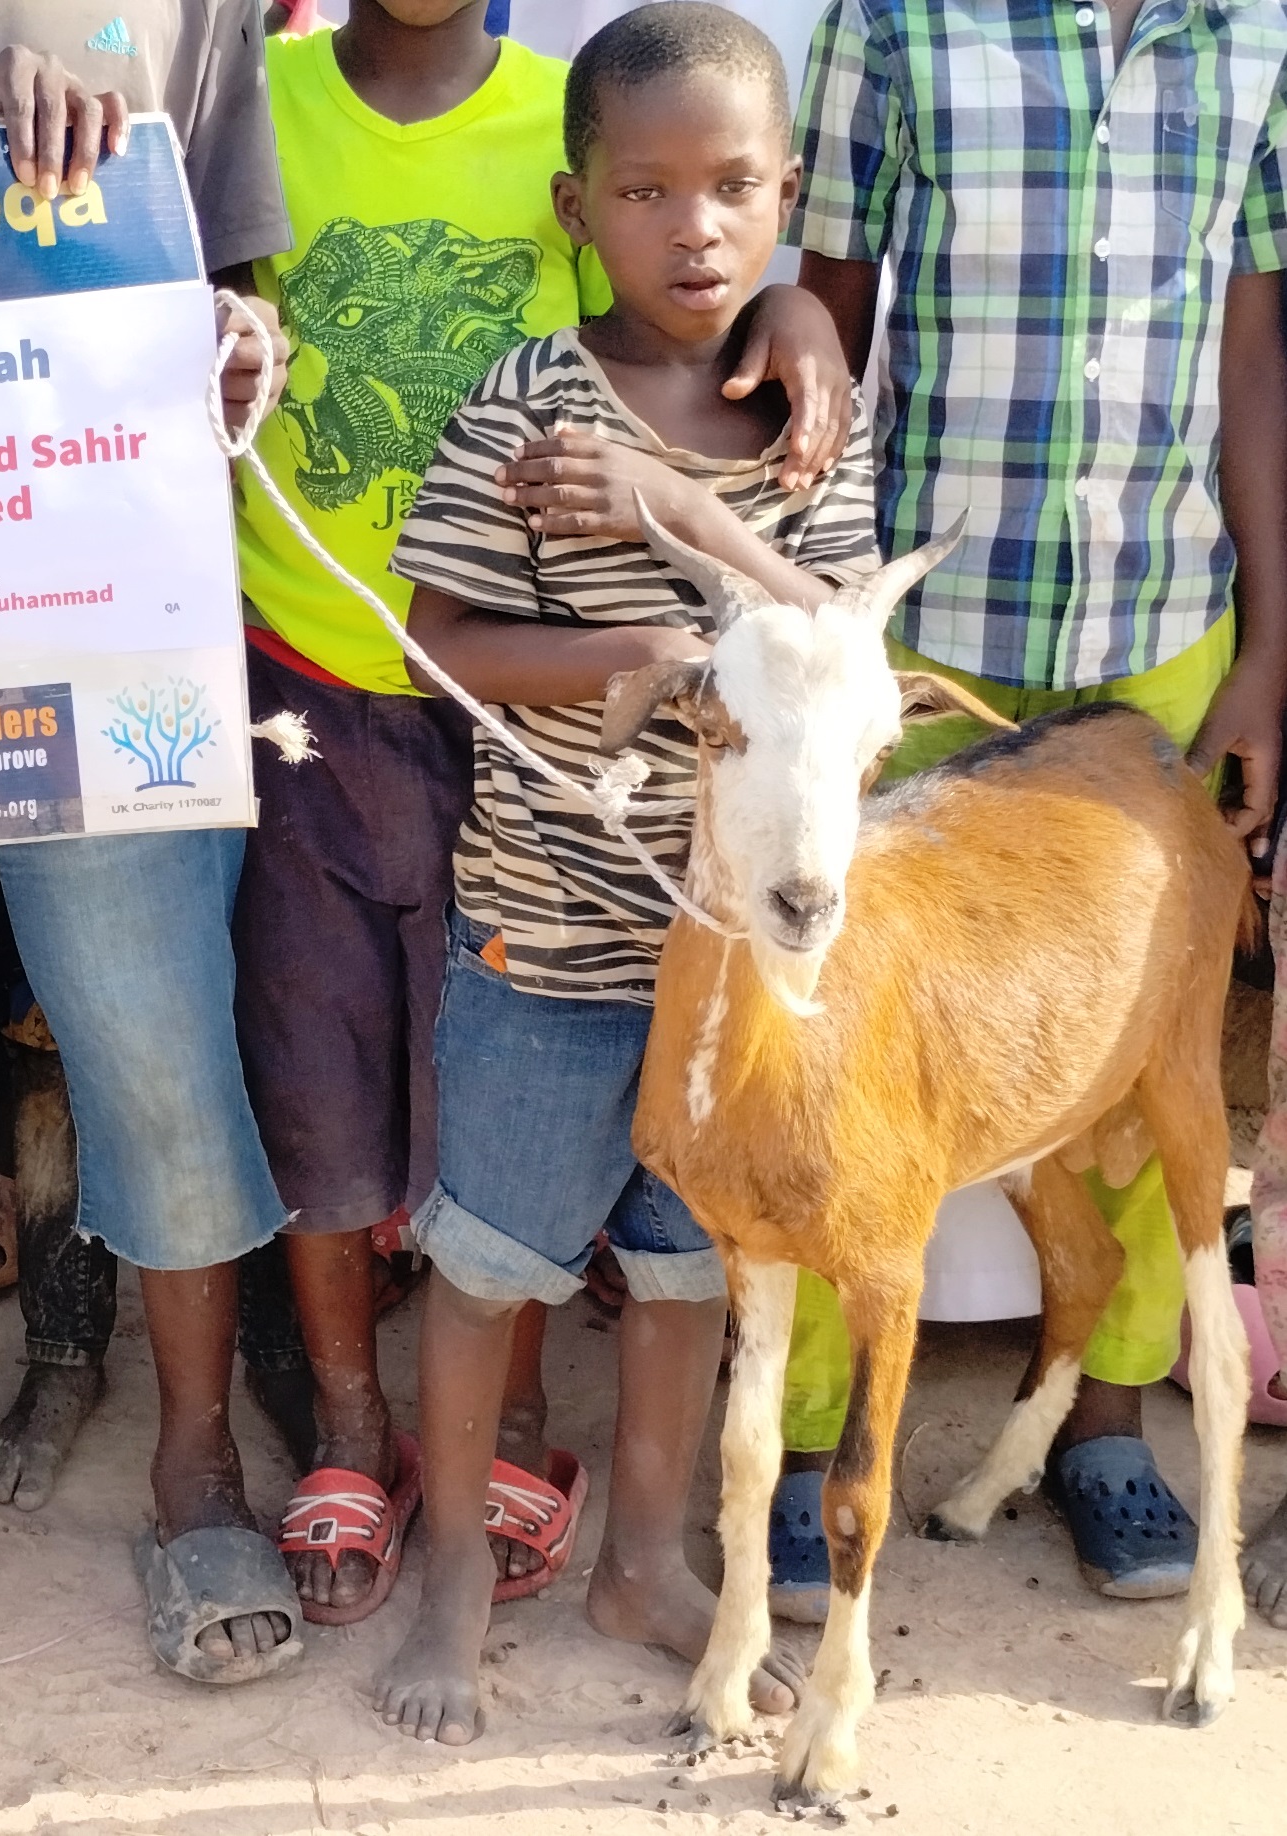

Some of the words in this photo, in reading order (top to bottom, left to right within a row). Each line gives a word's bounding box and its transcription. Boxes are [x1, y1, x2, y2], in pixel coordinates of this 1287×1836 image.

[31, 423, 148, 470] Sahir
[111, 804, 129, 814] UK
[133, 801, 174, 811] Charity
